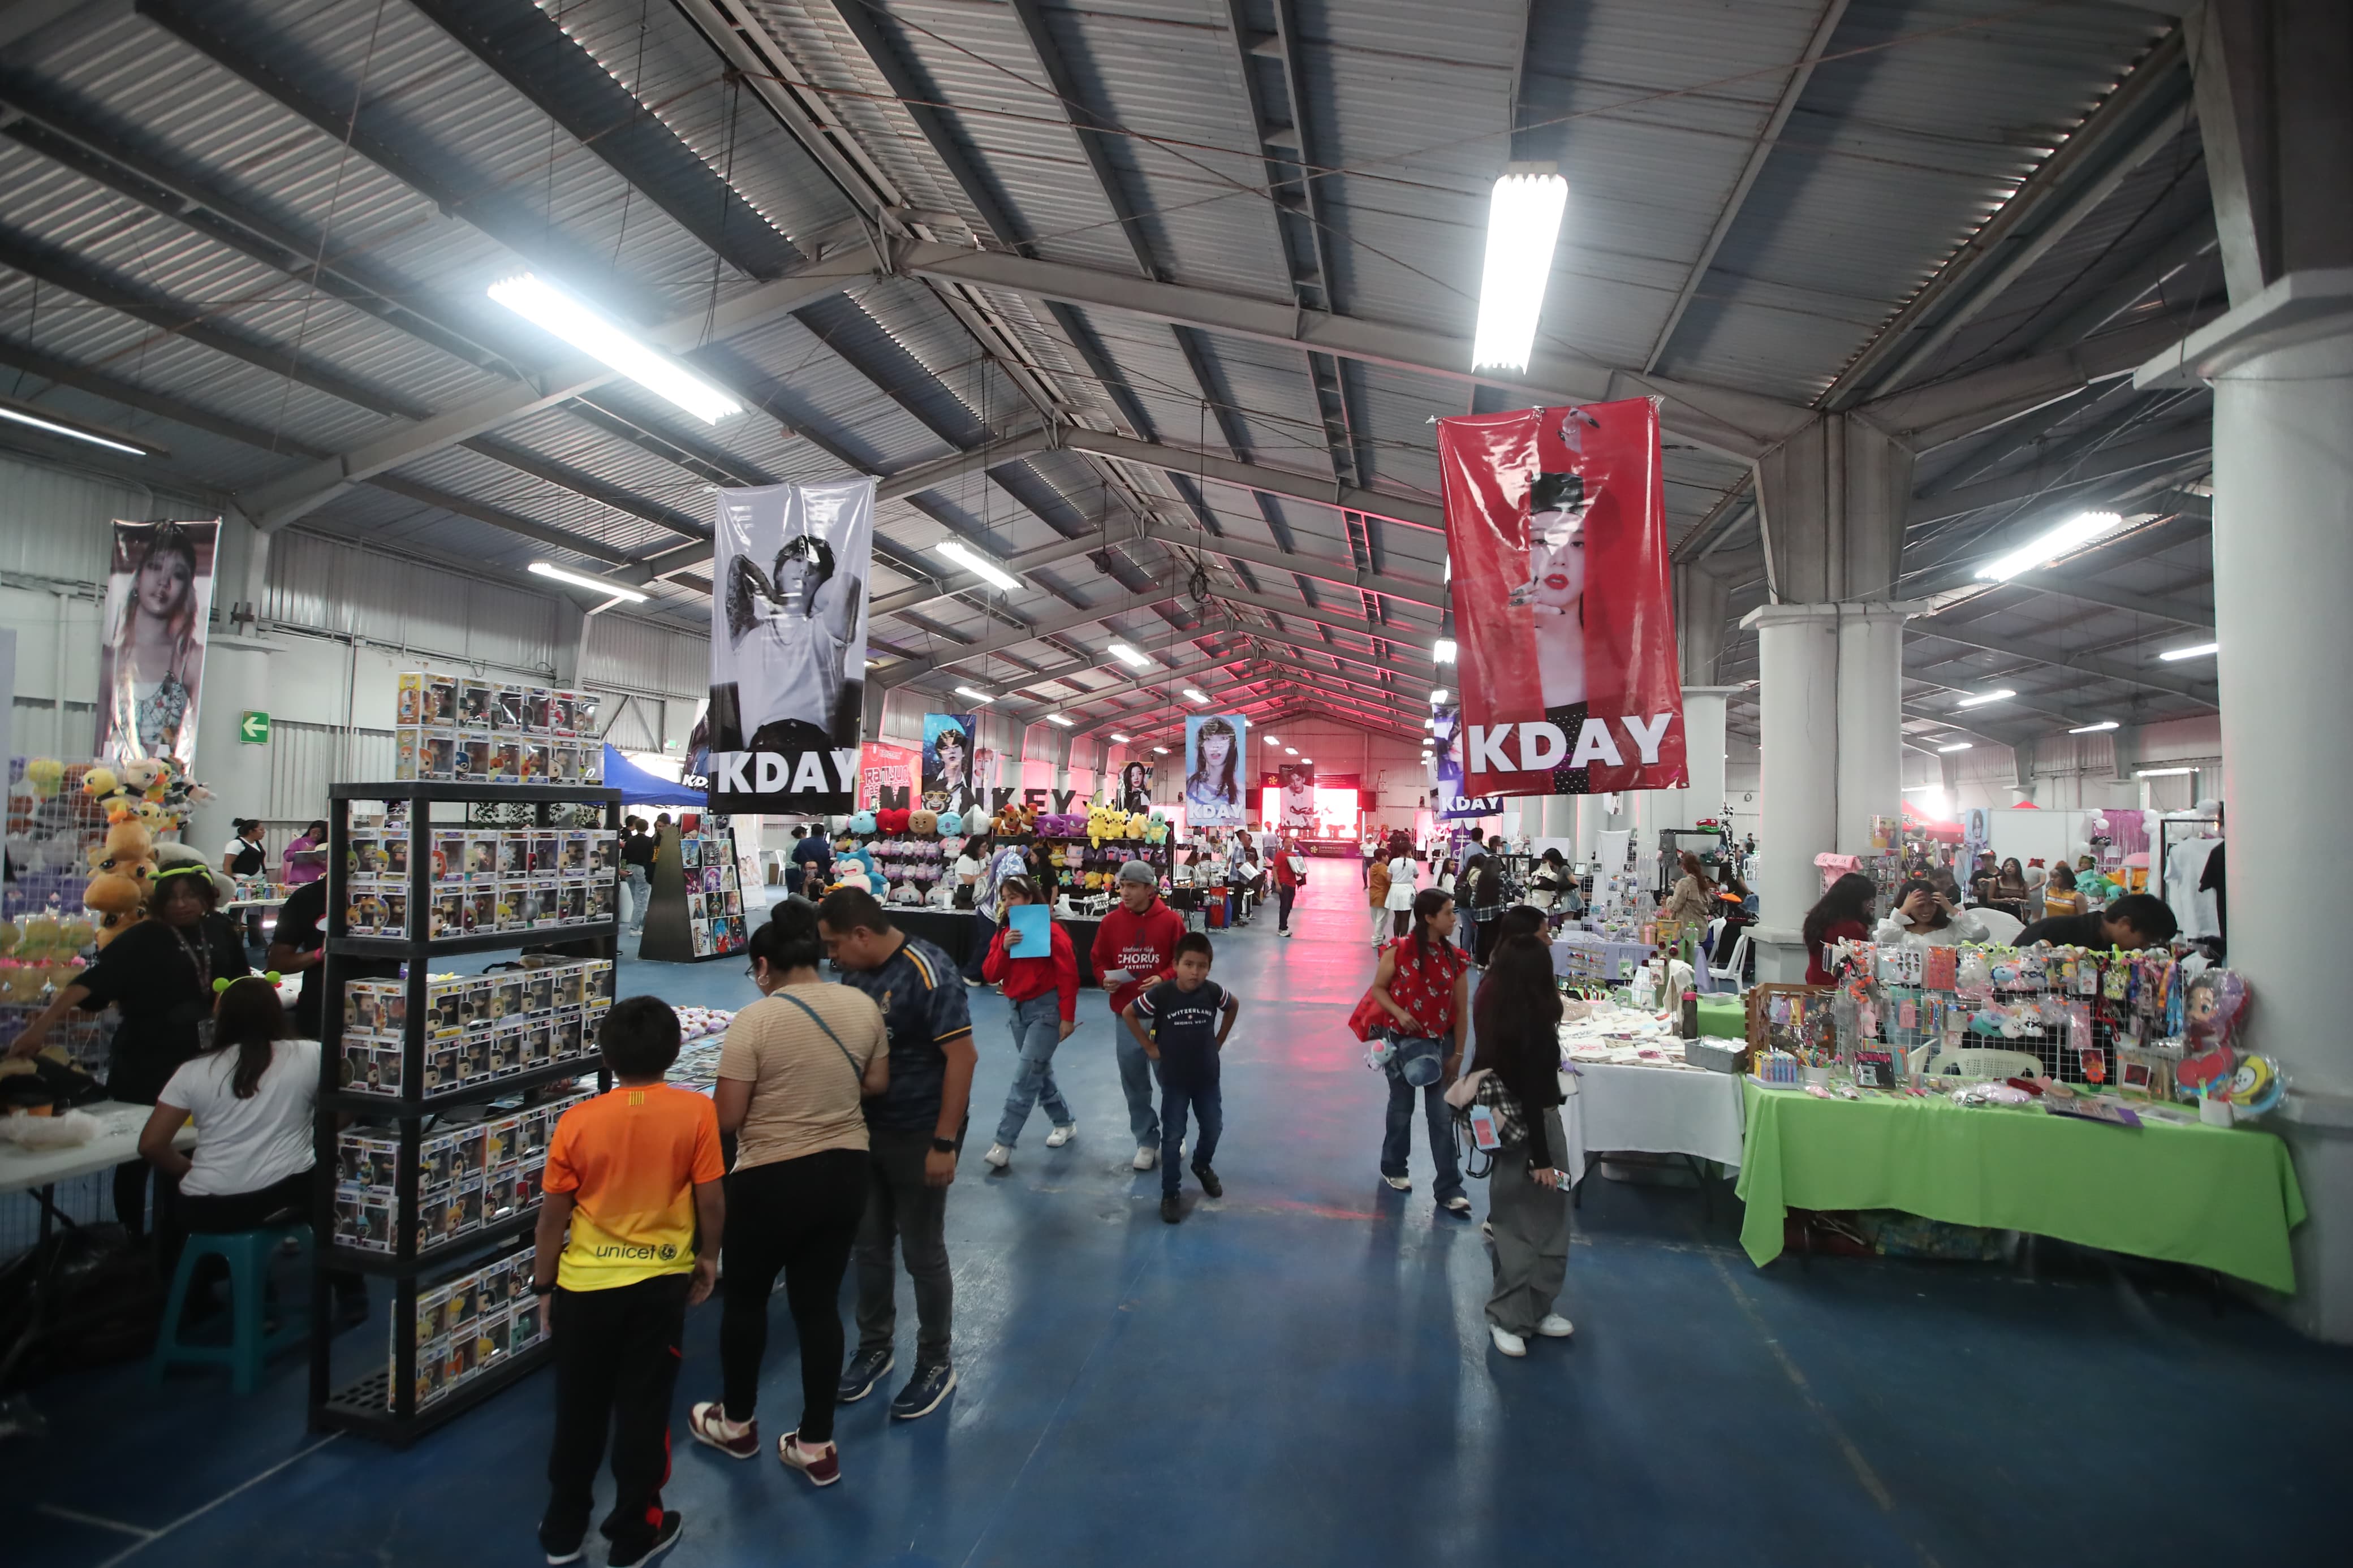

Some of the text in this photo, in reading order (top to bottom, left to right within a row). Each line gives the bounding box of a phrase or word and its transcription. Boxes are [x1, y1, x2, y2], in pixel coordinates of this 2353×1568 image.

[1468, 712, 1673, 774] KDAY
[718, 751, 858, 793] KDAY
[682, 774, 709, 788] KD
[1442, 796, 1499, 811] KDAY
[1189, 804, 1243, 819] KDAY
[1281, 817, 1315, 828] KDAY
[1118, 953, 1160, 964] CHORUS
[1167, 1008, 1212, 1020] SWITZERLAND
